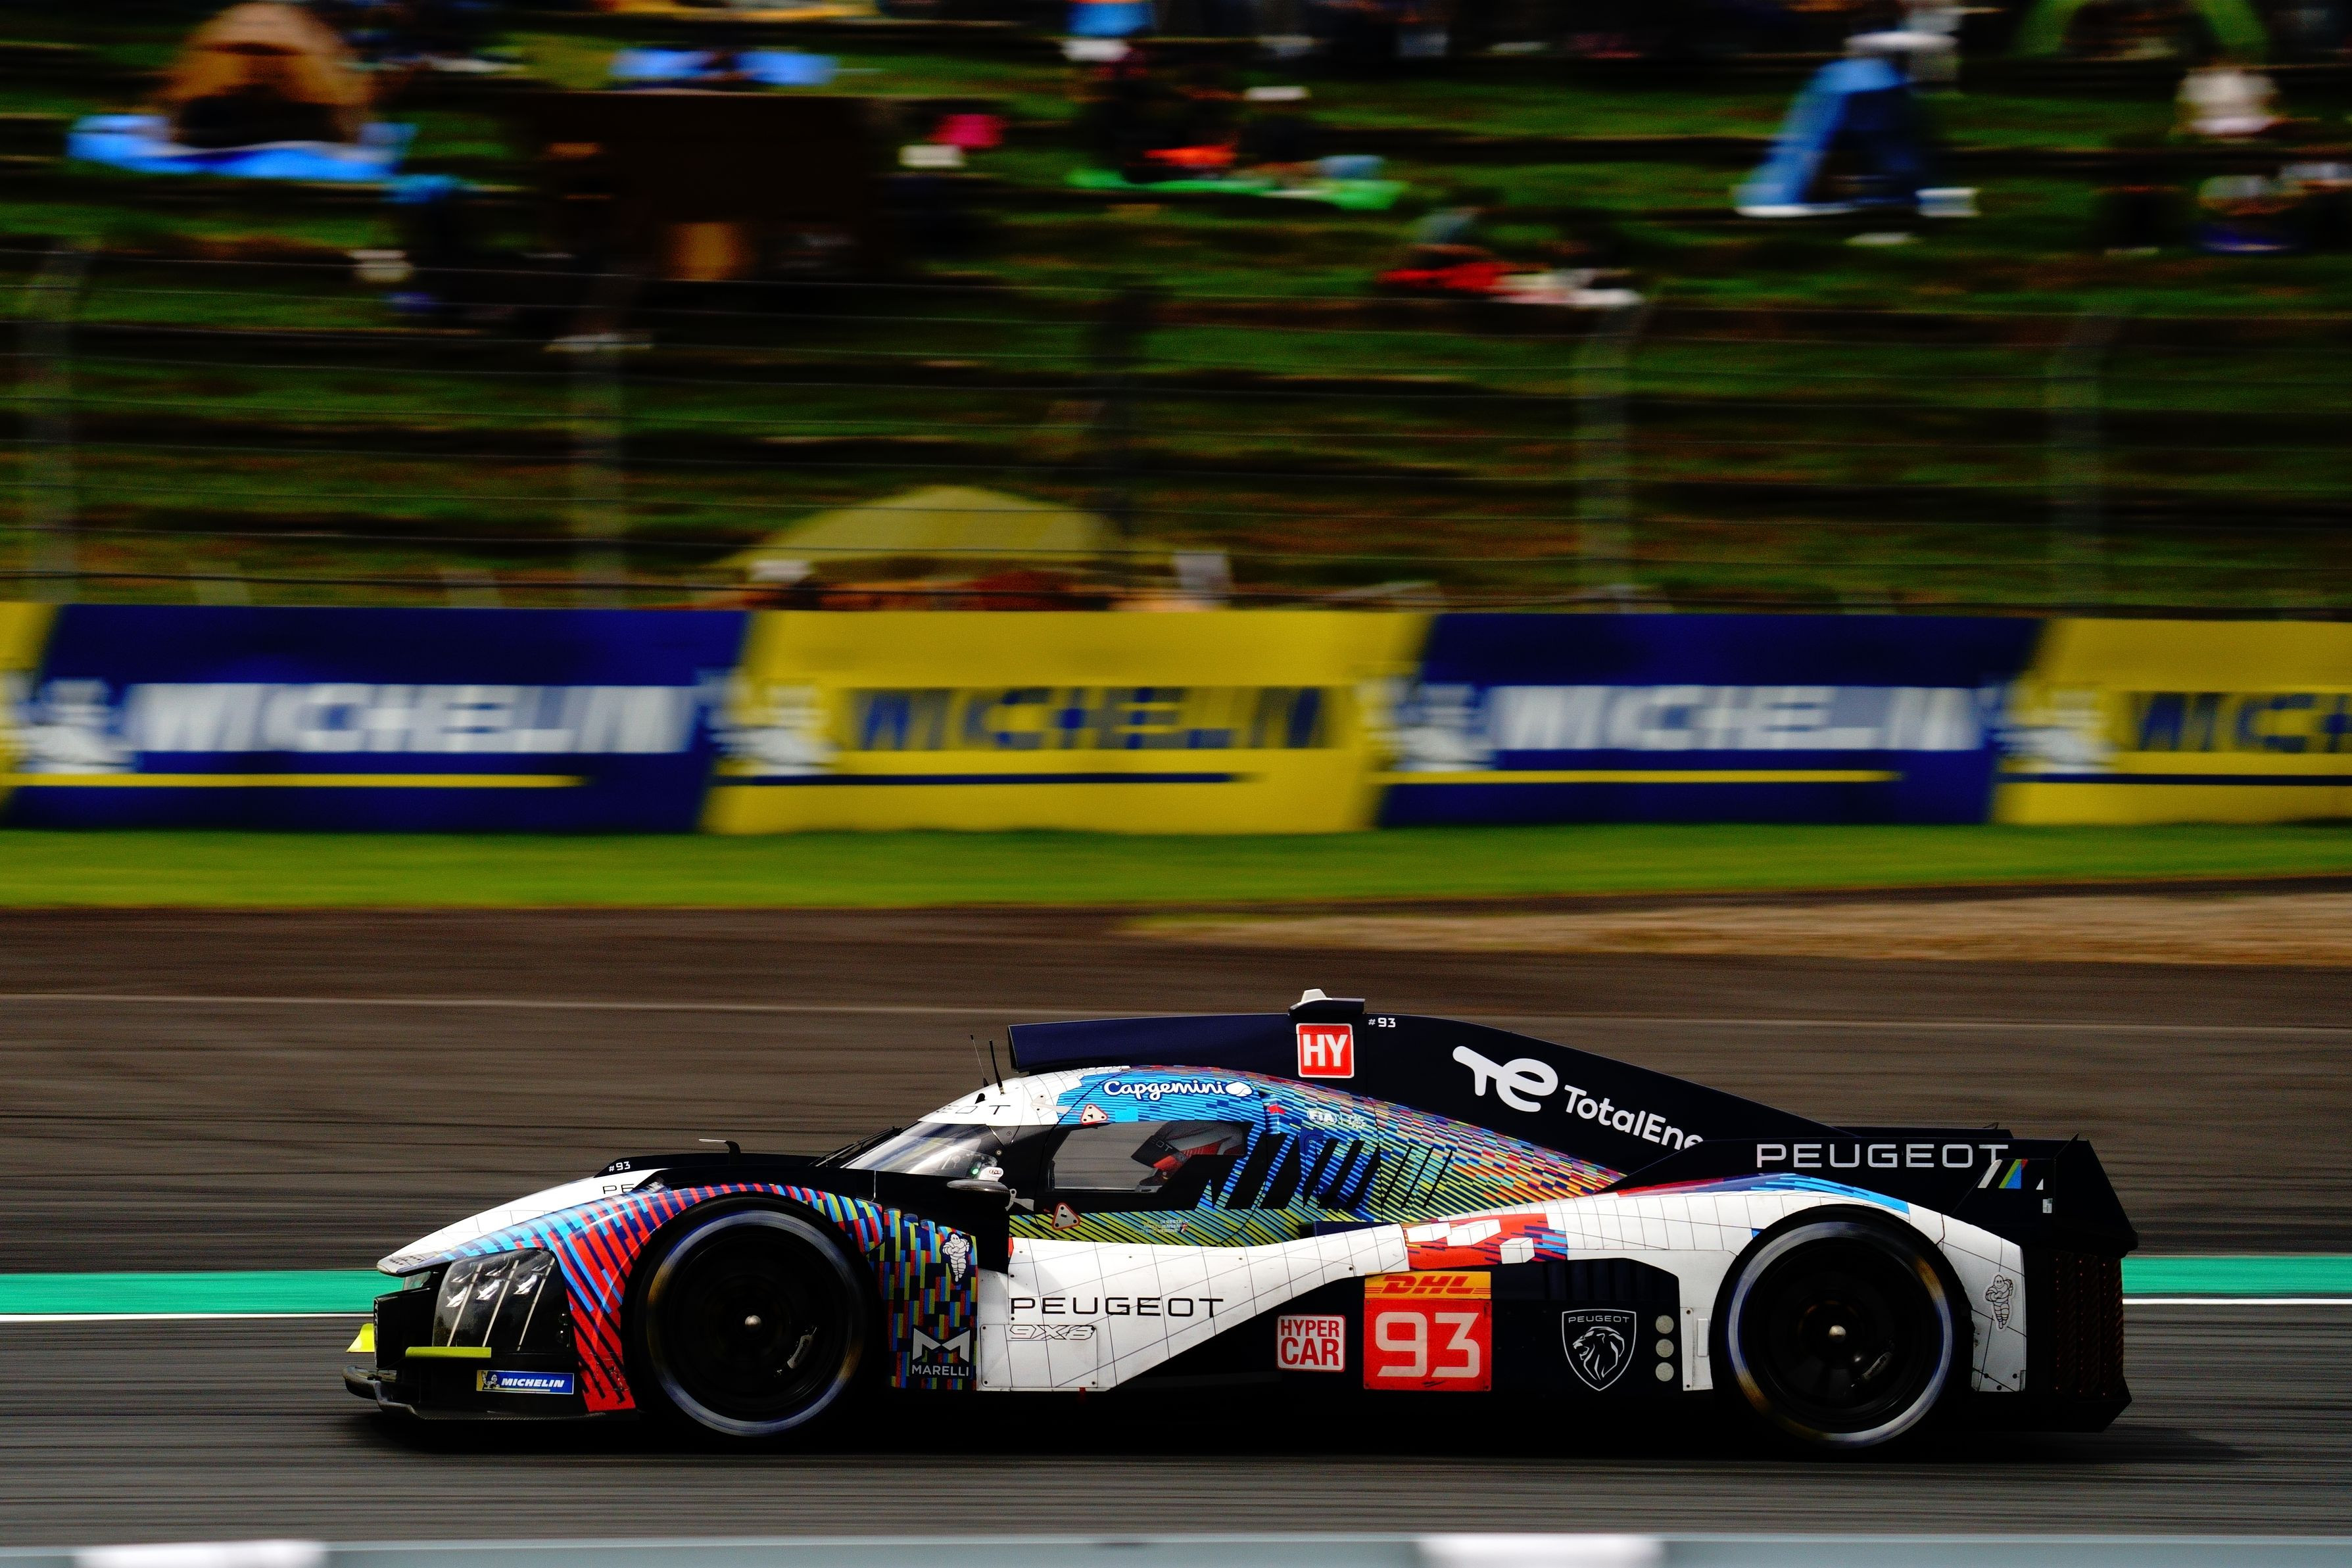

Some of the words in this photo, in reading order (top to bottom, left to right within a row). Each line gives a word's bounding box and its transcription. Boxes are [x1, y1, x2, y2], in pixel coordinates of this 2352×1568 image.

[1368, 1017, 1397, 1028] #93
[1303, 1033, 1349, 1067] HY
[1103, 1080, 1226, 1101] Capgemini
[1756, 1143, 2009, 1168] PEUGEOT
[608, 1160, 631, 1172] #93
[1381, 1275, 1475, 1295] DHL
[1011, 1297, 1224, 1318] PEUGEOT
[1280, 1319, 1340, 1337] HYPER
[1568, 1315, 1630, 1323] PEUGEOT
[1009, 1324, 1095, 1341] 9X8
[1281, 1337, 1340, 1366] CAR
[1375, 1311, 1480, 1378] 93
[911, 1364, 969, 1377] MARELLI
[501, 1377, 565, 1388] MICHELIN
